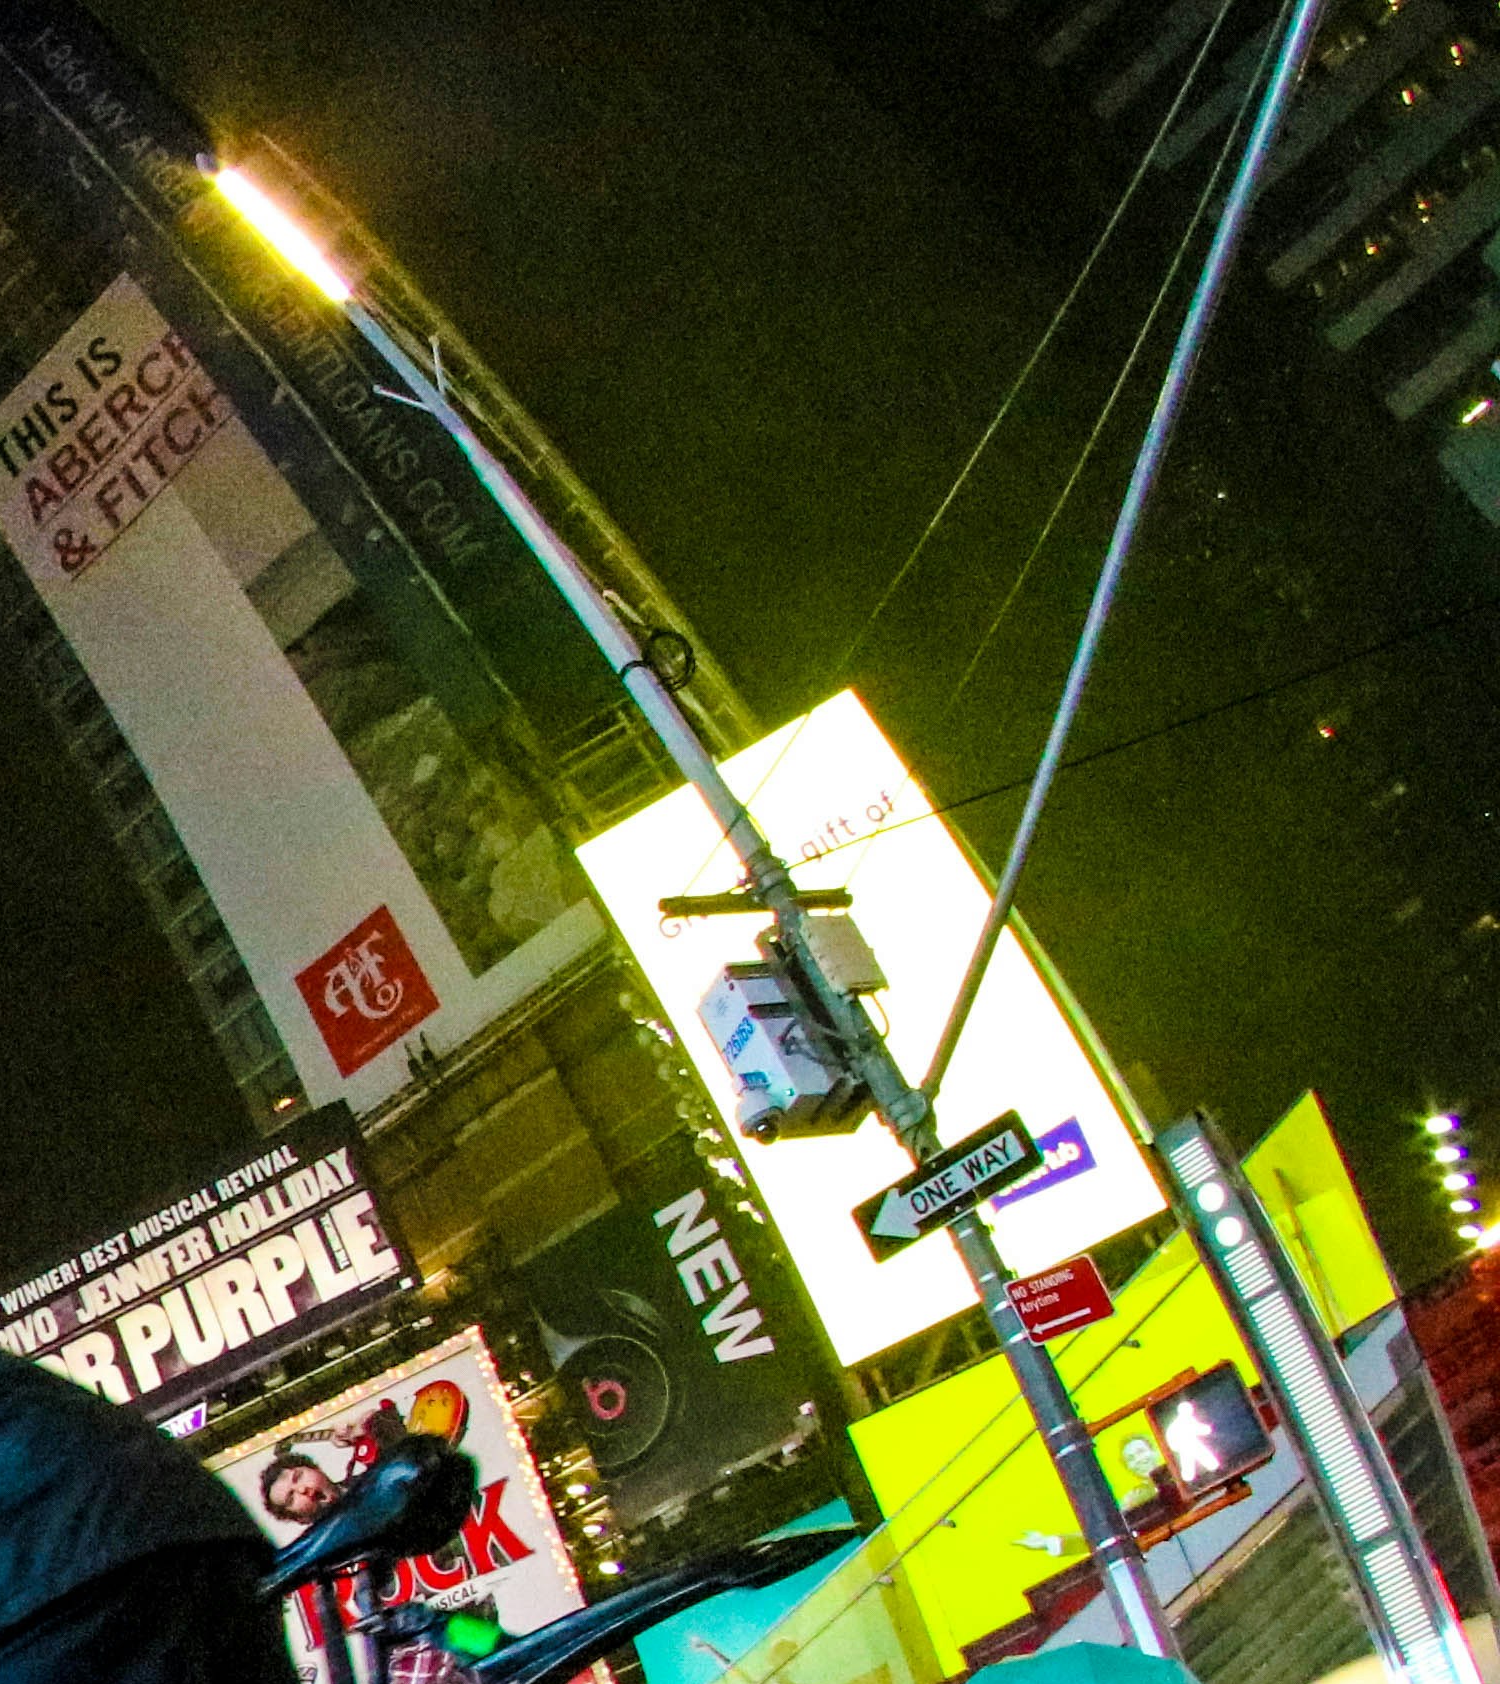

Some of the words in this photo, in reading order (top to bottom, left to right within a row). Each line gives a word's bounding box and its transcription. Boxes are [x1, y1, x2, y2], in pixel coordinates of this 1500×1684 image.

[77, 335, 123, 393] IS
[52, 527, 97, 574] &
[910, 1176, 961, 1215] ONE
[961, 1137, 1014, 1179] WAY
[0, 1257, 82, 1316] WINNER!
[80, 1232, 130, 1274] BEST
[130, 1188, 219, 1248] MUSICAL
[215, 1144, 299, 1201] REVIVAL
[76, 1226, 214, 1324] JENNIFER
[208, 1146, 356, 1253] HOLLIDAY
[115, 1190, 401, 1394] PURPLE
[653, 1187, 774, 1364] NEW
[1012, 1285, 1028, 1300] NO
[1028, 1268, 1074, 1295] STANDING
[1020, 1291, 1060, 1314] Anytime
